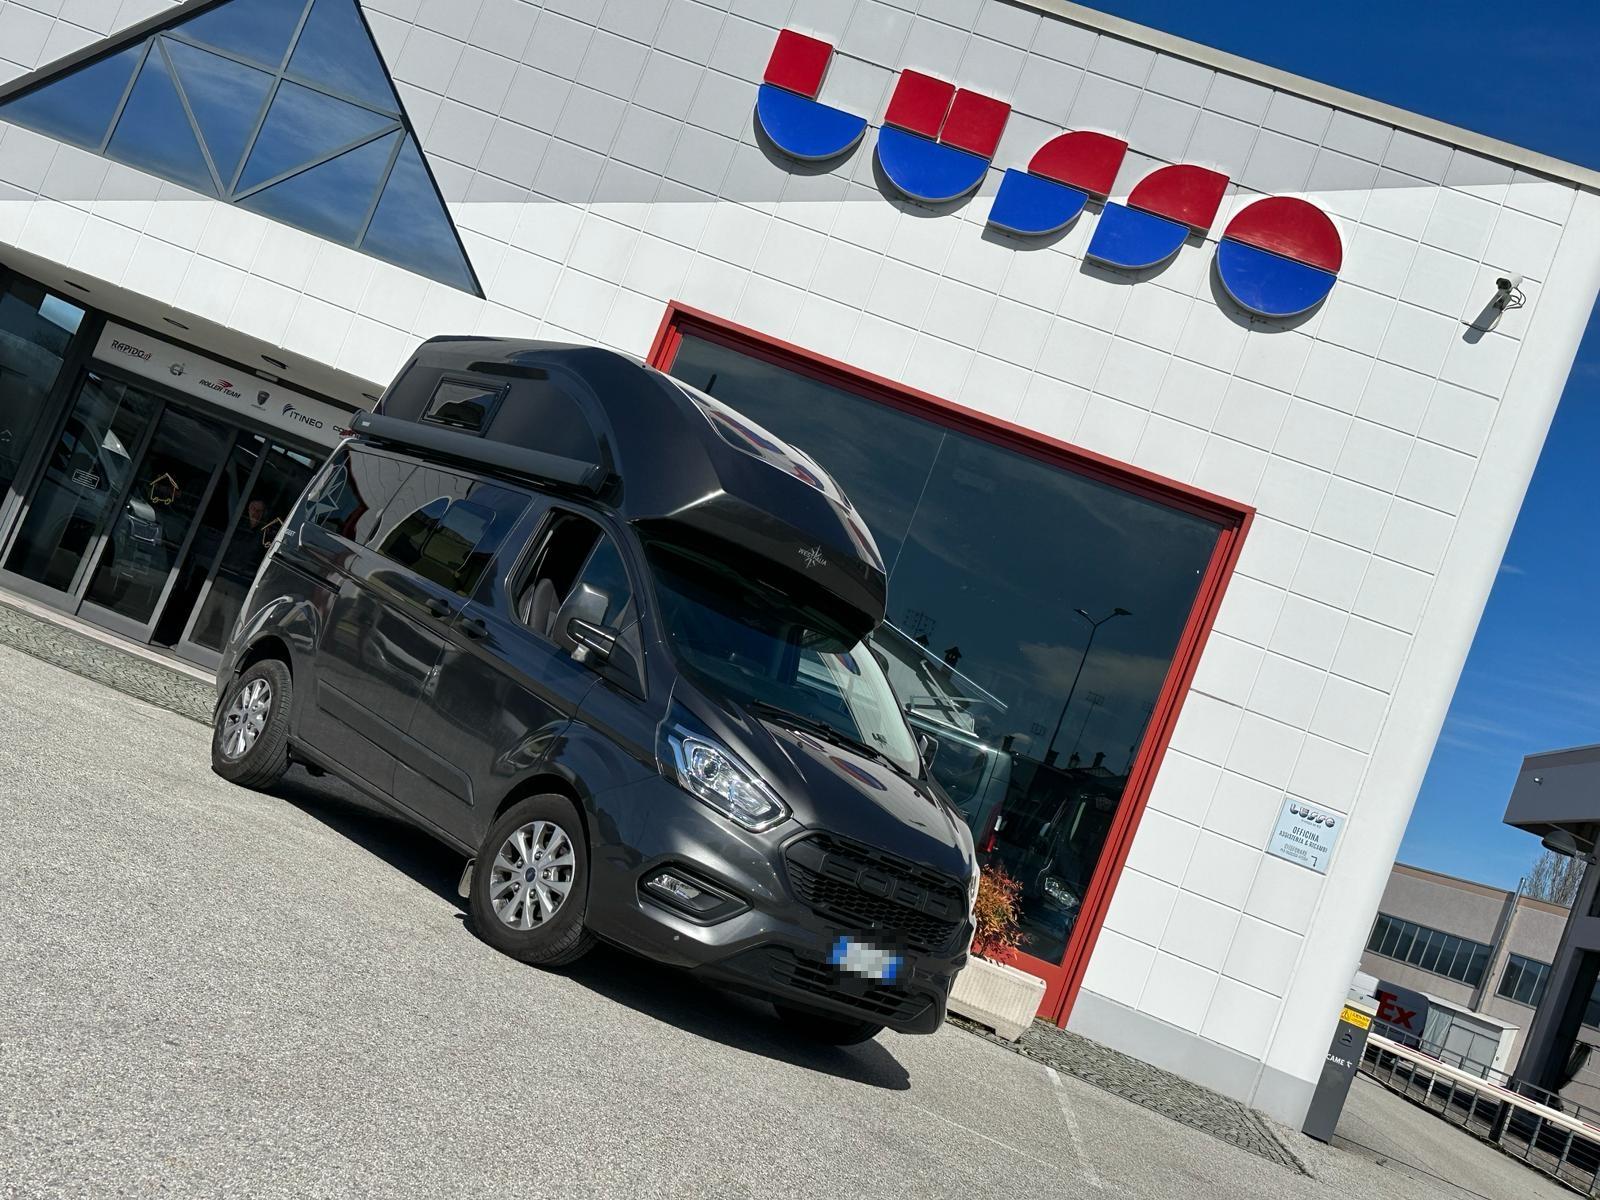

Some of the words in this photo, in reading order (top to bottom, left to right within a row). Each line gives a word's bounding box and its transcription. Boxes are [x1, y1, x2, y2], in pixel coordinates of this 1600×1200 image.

[199, 378, 223, 392] ROLLER
[223, 388, 241, 399] TEAM
[289, 411, 324, 429] ITINEO
[1279, 830, 1304, 844] ASSISTENZA
[1309, 841, 1328, 853] RICAMBI
[1292, 826, 1319, 842] OFFICINA
[1326, 1053, 1345, 1065] CAME
